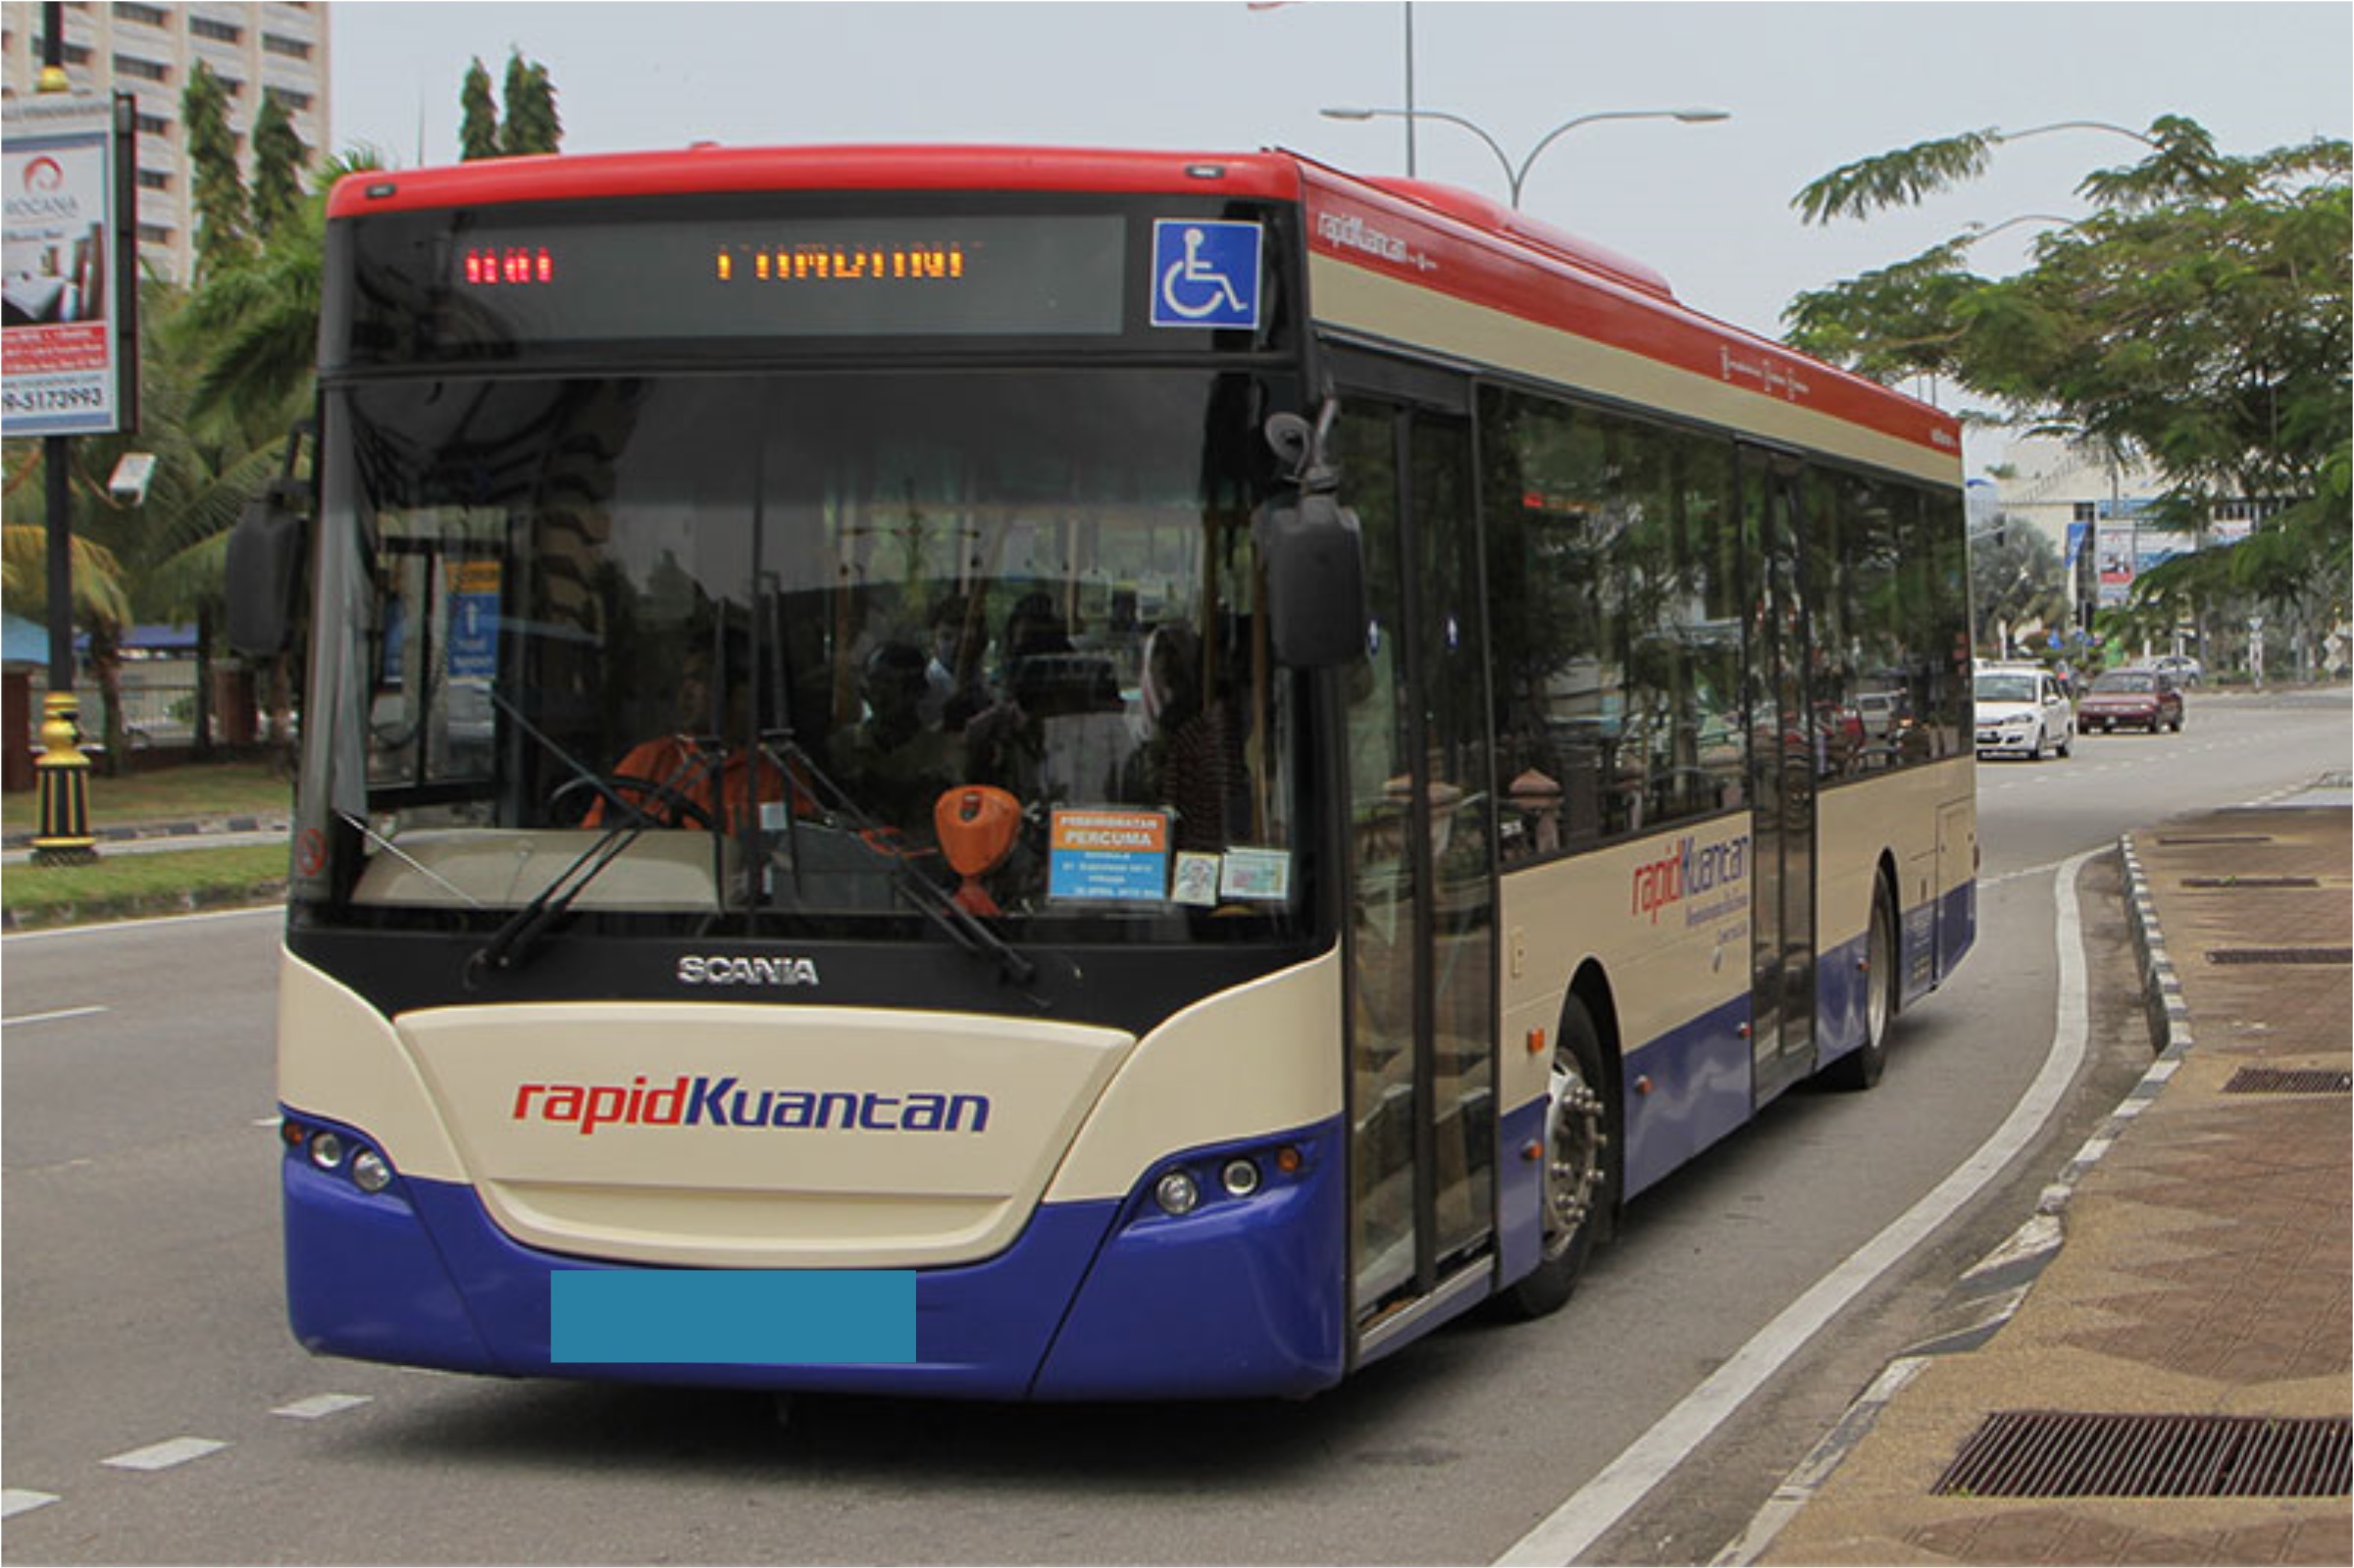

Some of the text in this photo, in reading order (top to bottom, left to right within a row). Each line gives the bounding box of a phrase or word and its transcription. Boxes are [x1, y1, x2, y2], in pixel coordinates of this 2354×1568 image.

[1065, 831, 1151, 847] PERCUMA
[679, 956, 818, 985] SCANIA
[513, 1077, 991, 1136] rapidKuantan
